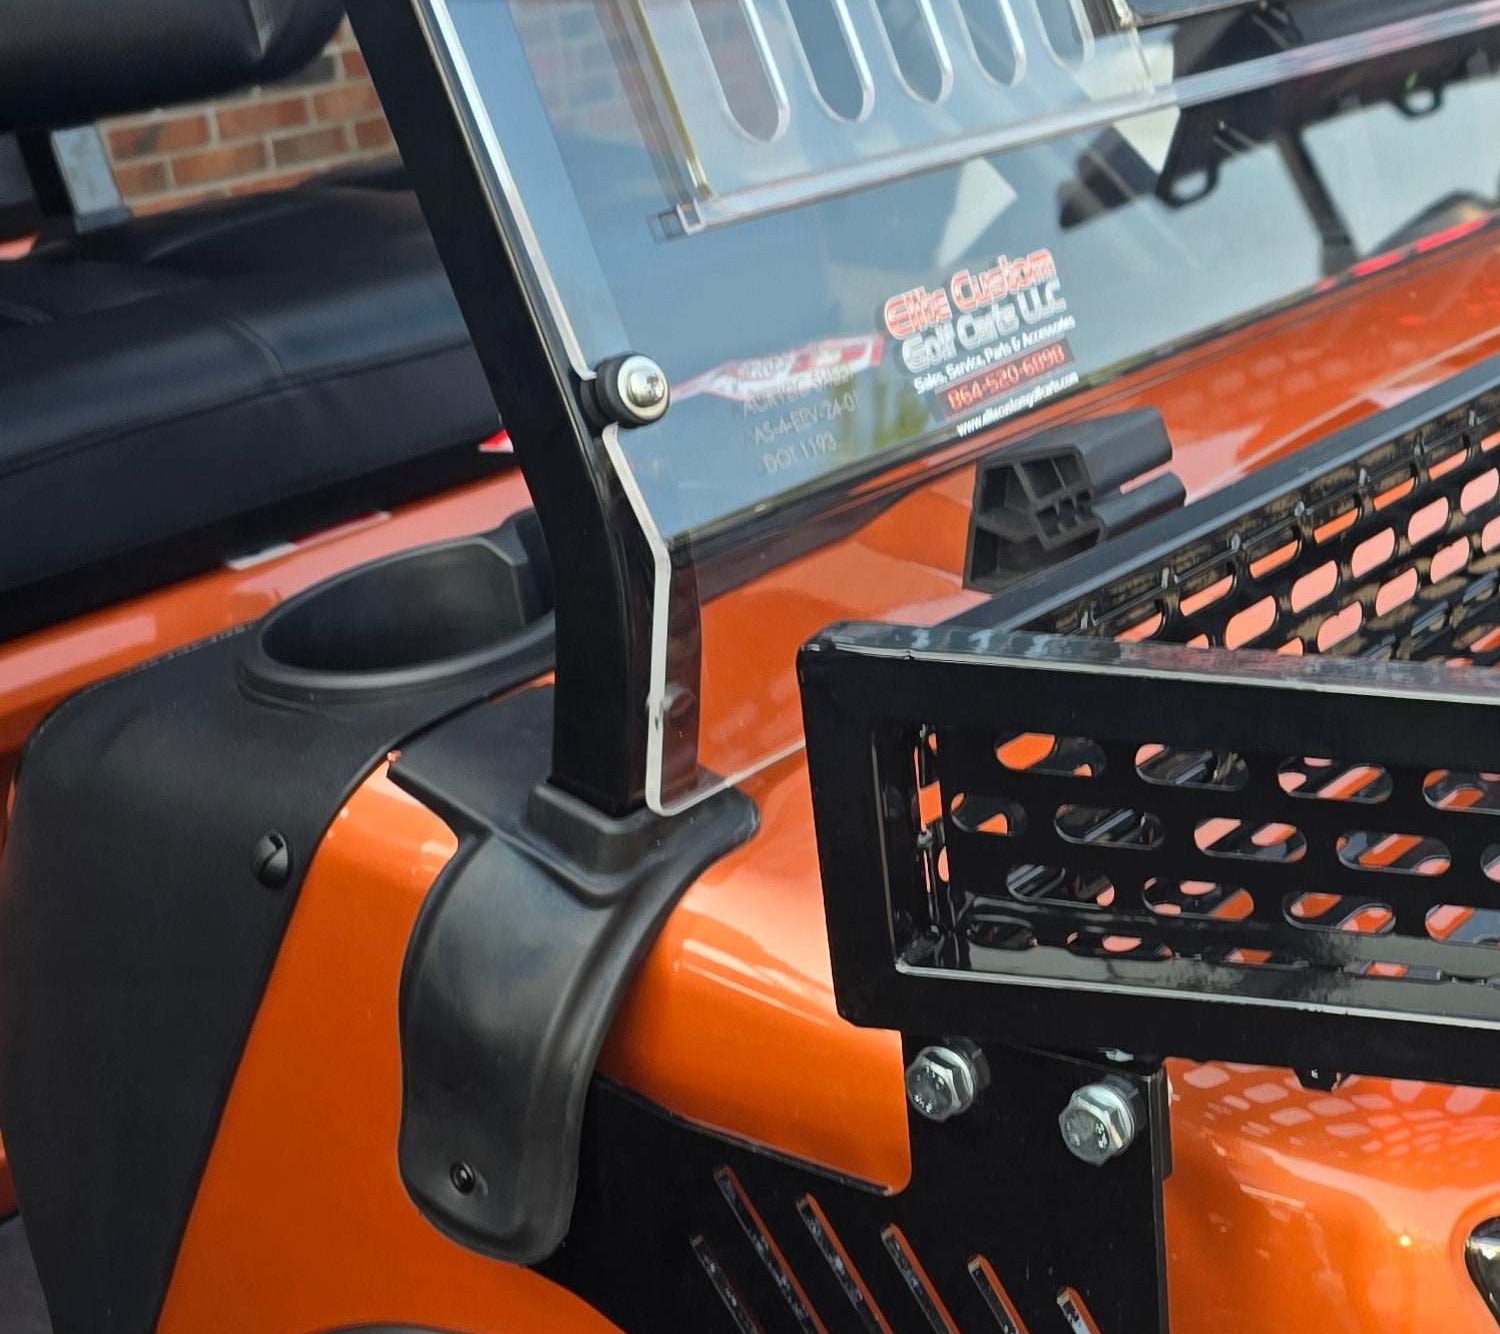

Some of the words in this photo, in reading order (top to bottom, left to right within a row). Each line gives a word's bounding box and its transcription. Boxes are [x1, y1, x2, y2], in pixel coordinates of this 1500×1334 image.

[884, 286, 953, 340] Elite
[951, 248, 1057, 313] Custom
[902, 320, 958, 373] Golf
[957, 303, 1019, 350] Carts
[1017, 277, 1067, 325] LLC
[984, 339, 1012, 363] Parts
[1010, 336, 1021, 353] &
[1022, 315, 1076, 349] Accessories
[762, 447, 799, 475] DOT
